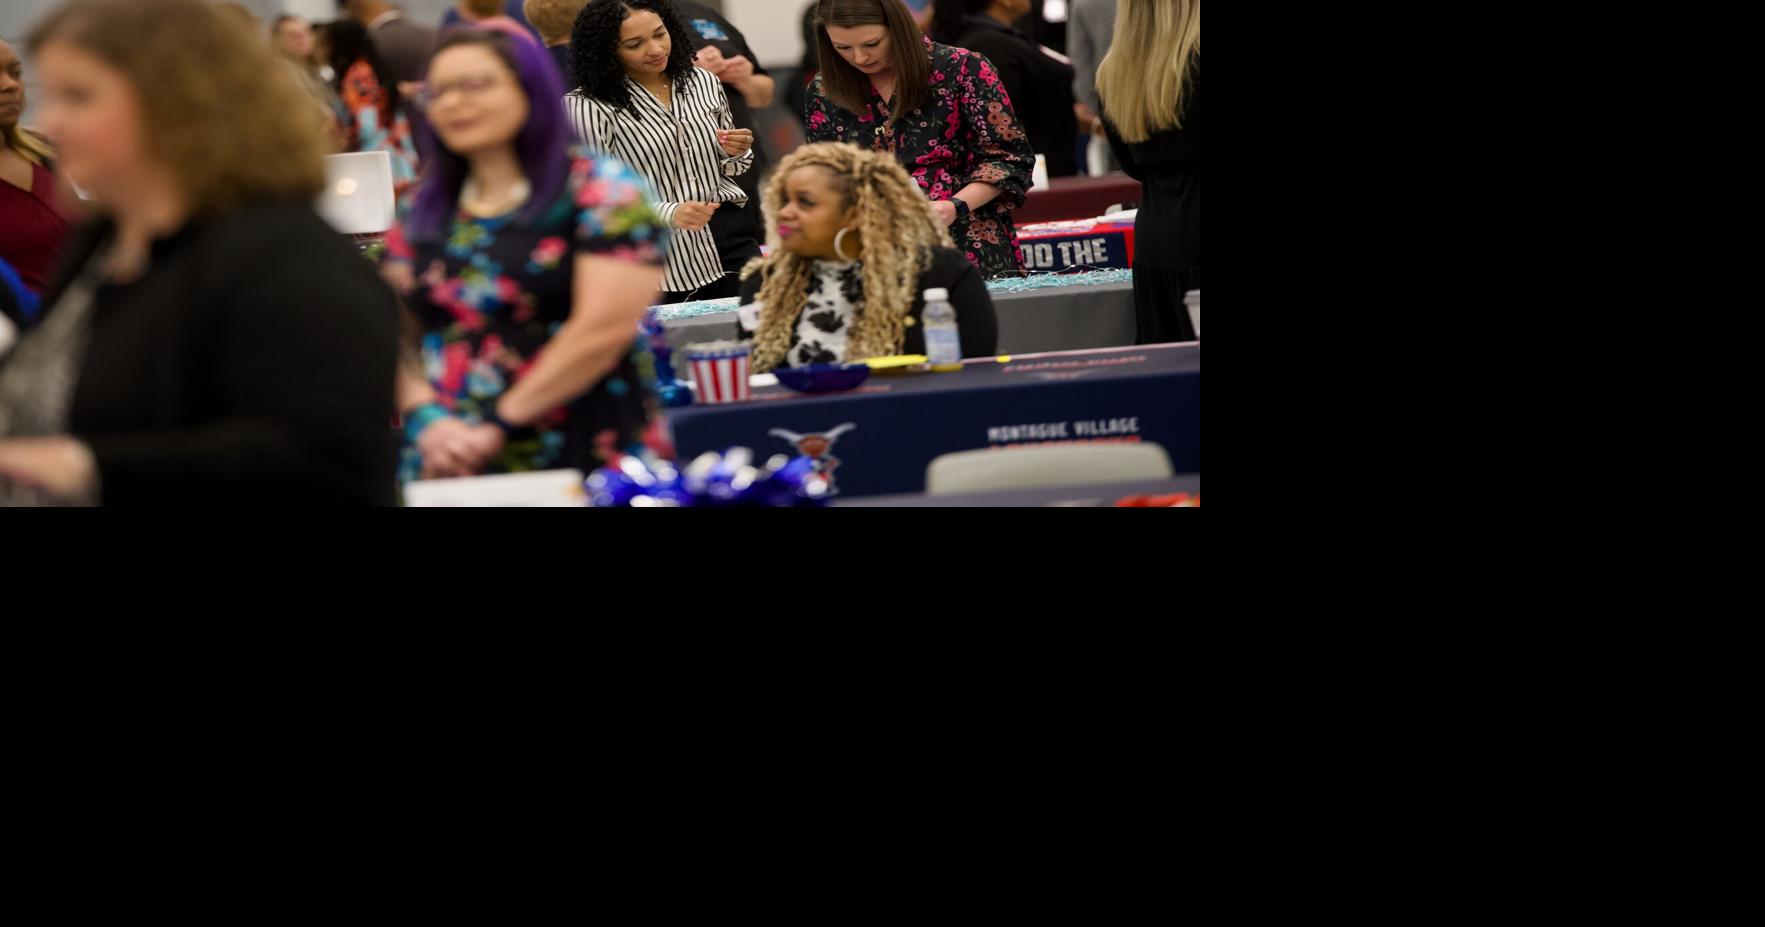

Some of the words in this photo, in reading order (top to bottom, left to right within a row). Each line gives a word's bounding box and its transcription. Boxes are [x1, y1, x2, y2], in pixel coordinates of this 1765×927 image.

[1057, 238, 1108, 266] THE
[987, 421, 1068, 442] MONTAGUE
[1073, 416, 1139, 436] VILLAGE
